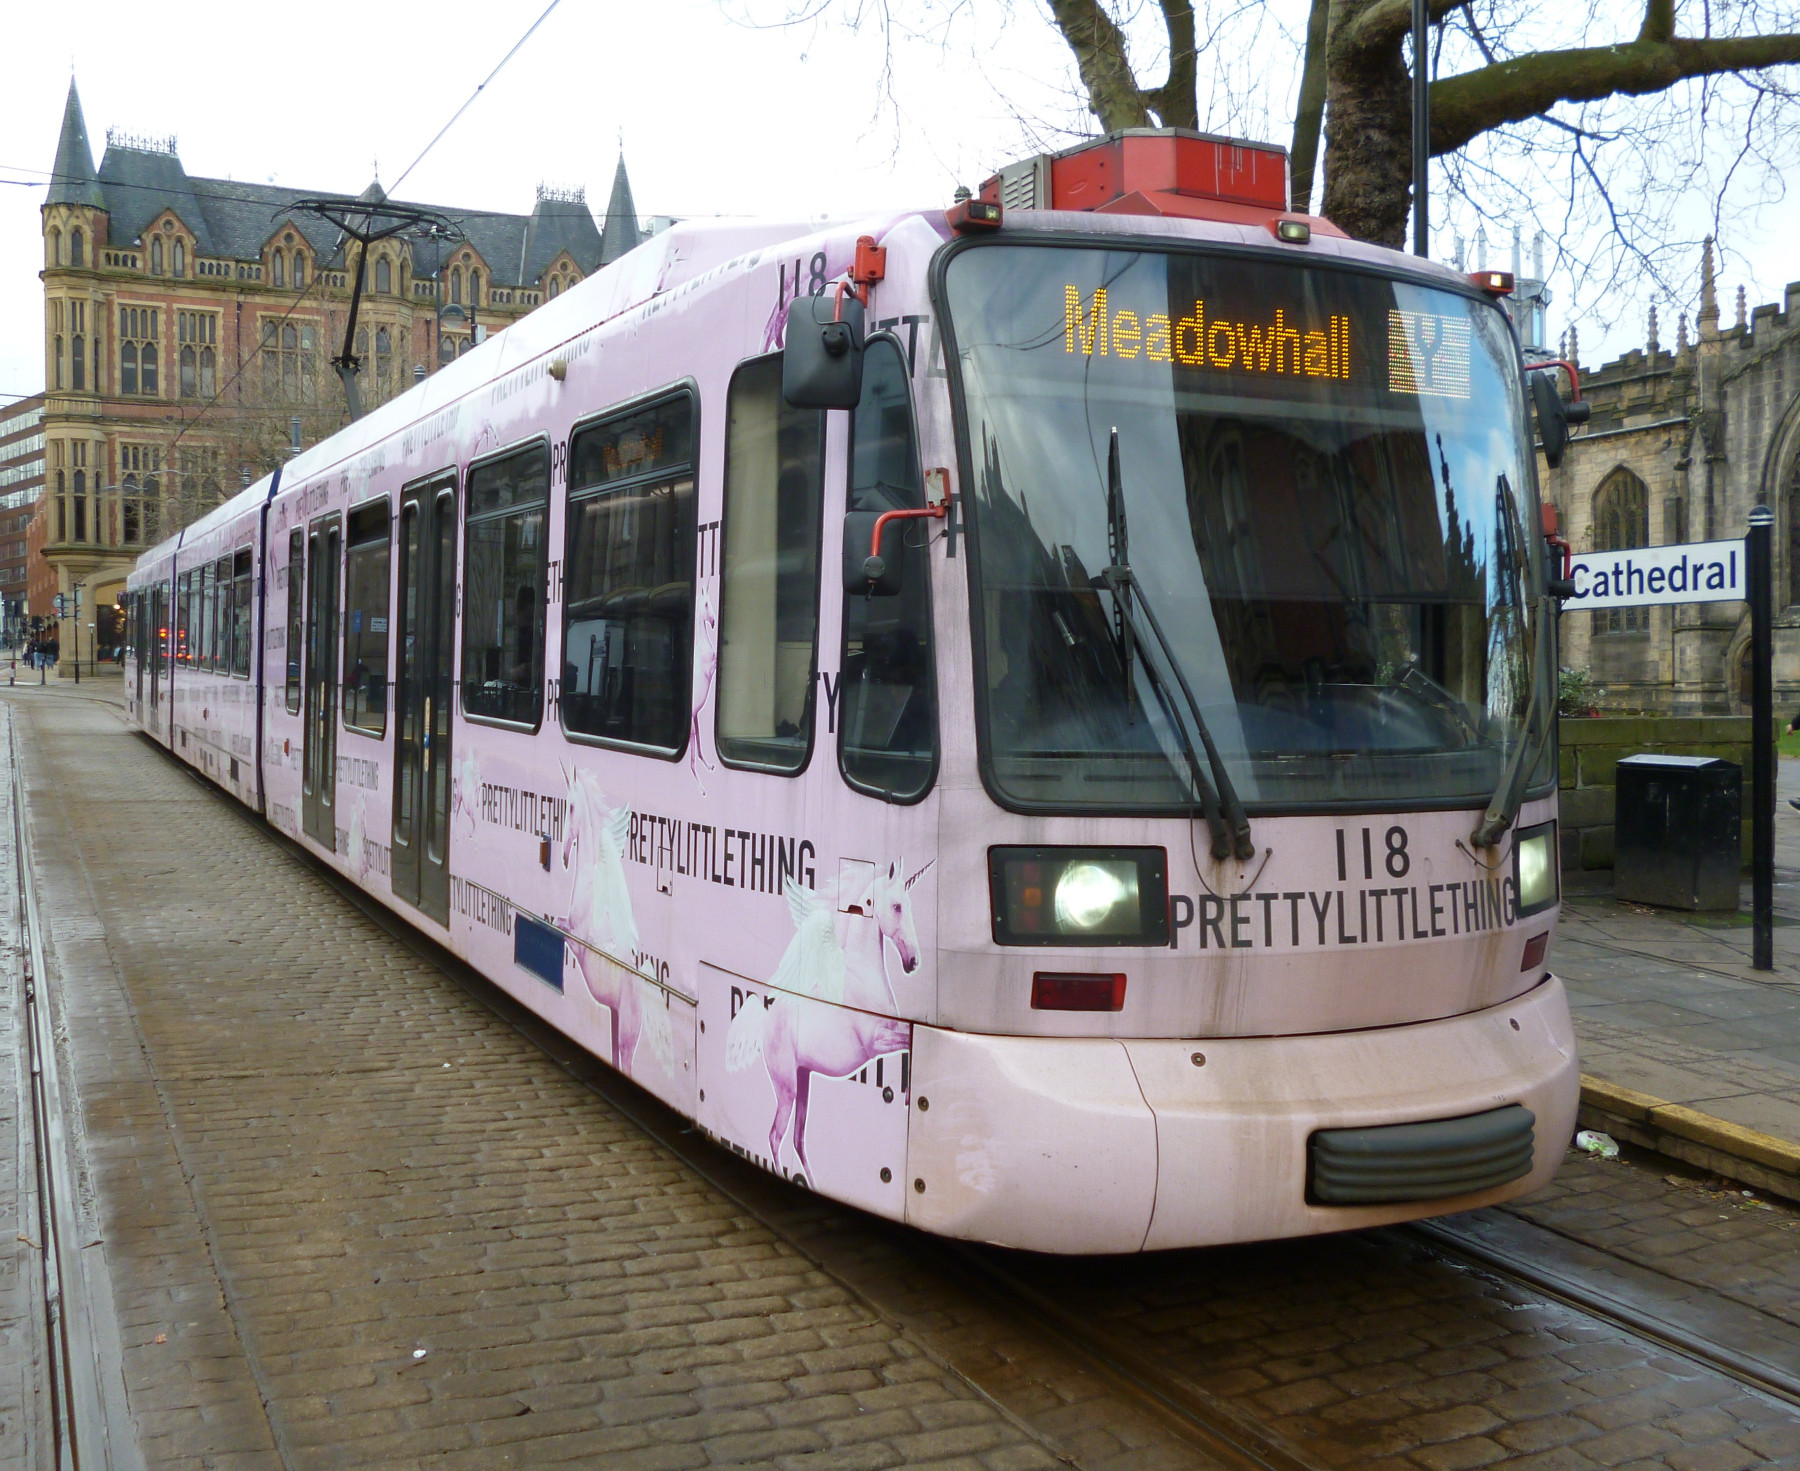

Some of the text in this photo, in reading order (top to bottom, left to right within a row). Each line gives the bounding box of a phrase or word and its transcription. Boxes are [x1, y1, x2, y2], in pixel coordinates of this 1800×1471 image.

[1065, 284, 1350, 380] Meadowhall
[1571, 550, 1737, 600] Cathedral
[622, 812, 817, 896] RETTYLITTLETHING
[1336, 826, 1410, 881] 118
[1170, 876, 1516, 950] PRETTYLITTLETHING
